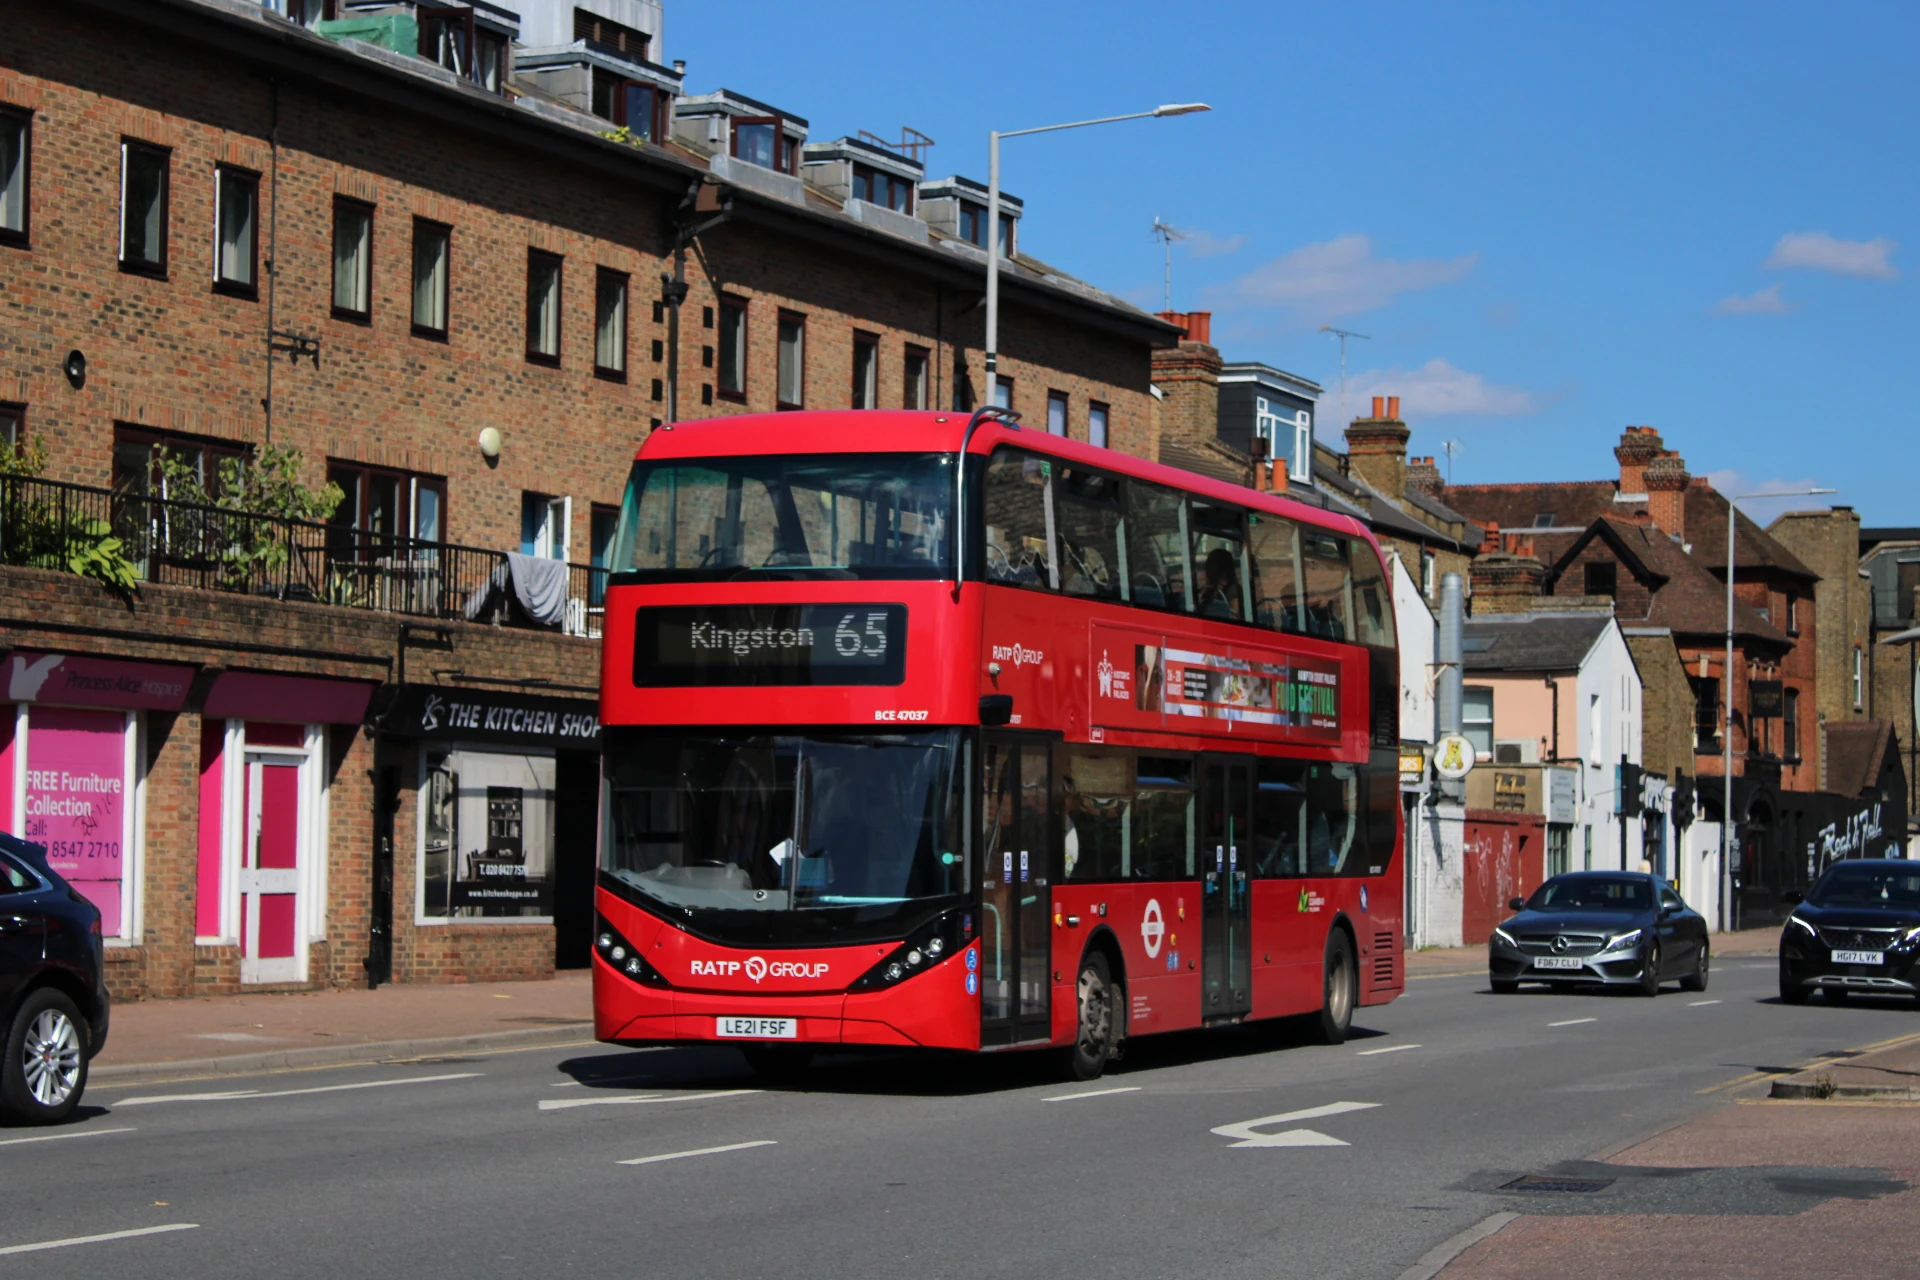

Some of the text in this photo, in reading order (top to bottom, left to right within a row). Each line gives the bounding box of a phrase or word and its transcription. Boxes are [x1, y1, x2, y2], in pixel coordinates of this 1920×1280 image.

[691, 612, 888, 657] Kingston 65
[992, 645, 1044, 664] RATP GROUP
[65, 669, 183, 698] Princess Alice Hospice
[1276, 681, 1336, 716] FOOD FESTIVAL
[448, 703, 482, 729] THE
[484, 706, 557, 735] KITCHEN
[874, 711, 929, 721] BCE 47037
[26, 770, 121, 794] FREE Furniture
[25, 794, 92, 817] Collection
[25, 819, 48, 836] Call:
[51, 841, 84, 858] 8547
[87, 841, 120, 859] 2710
[485, 864, 498, 876] 020
[1537, 957, 1579, 968] FD67 CLU
[1836, 951, 1877, 962] HG17 LVK
[690, 960, 829, 978] RATP GROUP
[725, 1020, 787, 1036] LE21 FSF
